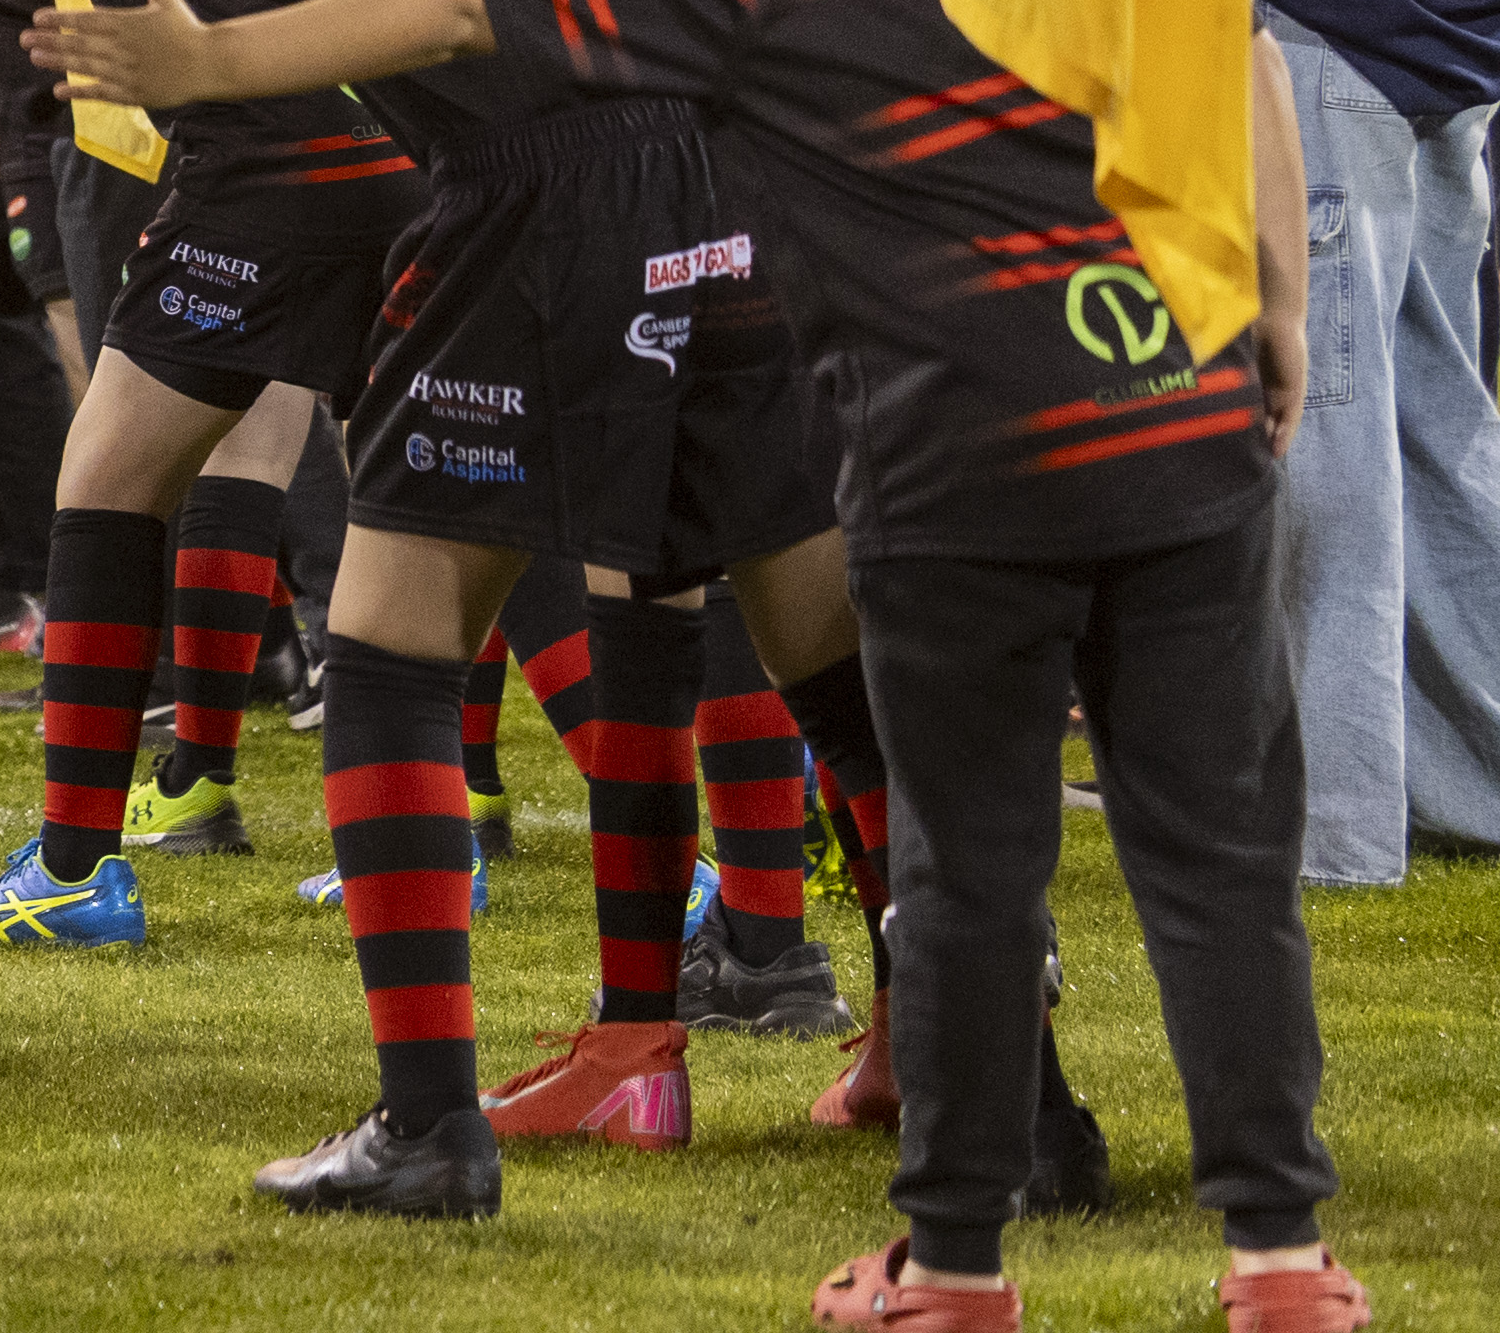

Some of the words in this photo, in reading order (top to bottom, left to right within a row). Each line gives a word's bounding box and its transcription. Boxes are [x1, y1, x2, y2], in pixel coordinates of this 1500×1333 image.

[169, 241, 259, 283] HAWKER
[649, 255, 692, 289] BAGS
[188, 294, 242, 321] Capital
[408, 371, 526, 415] HAWKER
[441, 439, 517, 466] Capital
[442, 457, 527, 484] Asphalt
